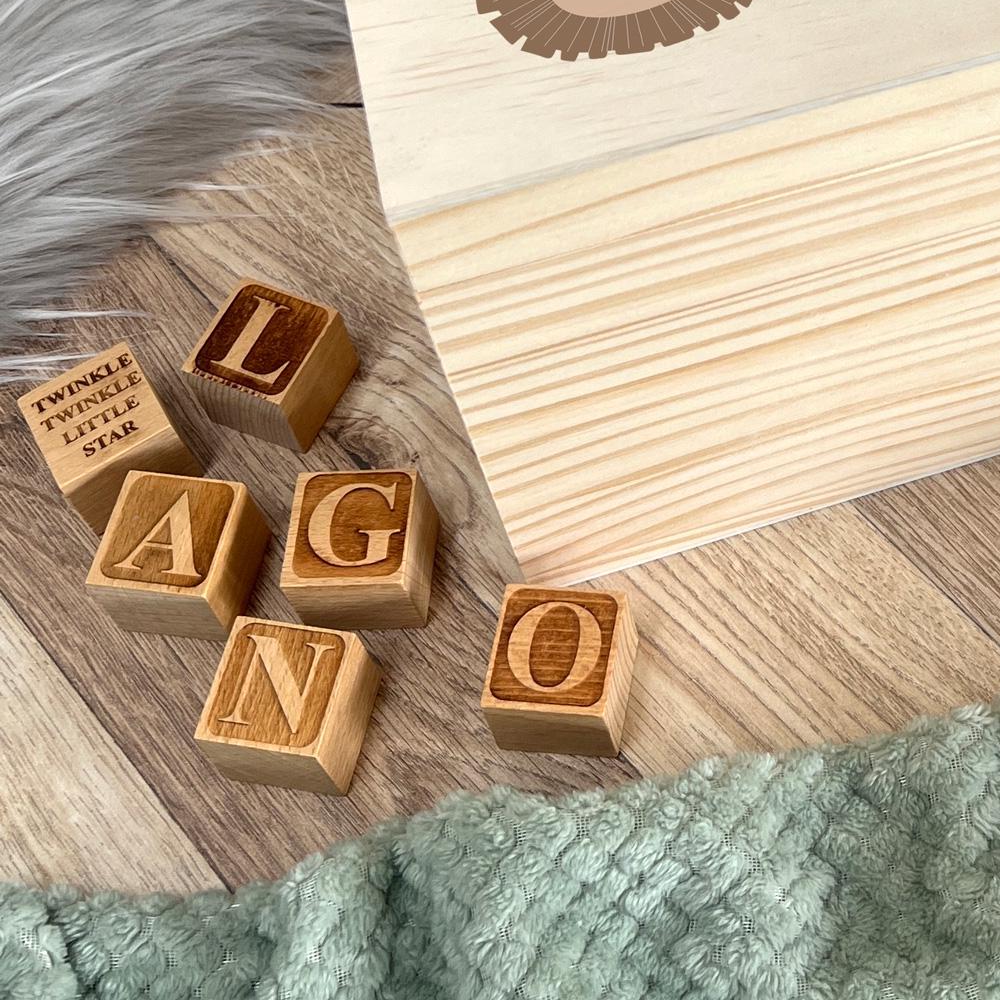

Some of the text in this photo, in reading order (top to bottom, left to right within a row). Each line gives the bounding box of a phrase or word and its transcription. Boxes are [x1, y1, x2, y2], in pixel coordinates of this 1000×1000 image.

[31, 353, 133, 413] TWINKLE
[210, 295, 291, 385] L
[40, 371, 142, 432] TWINKLE
[62, 396, 140, 445] LITTLE
[82, 420, 139, 457] STAR
[113, 490, 203, 579] A
[307, 481, 402, 568] G
[217, 633, 336, 735] N
[507, 601, 603, 693] O
